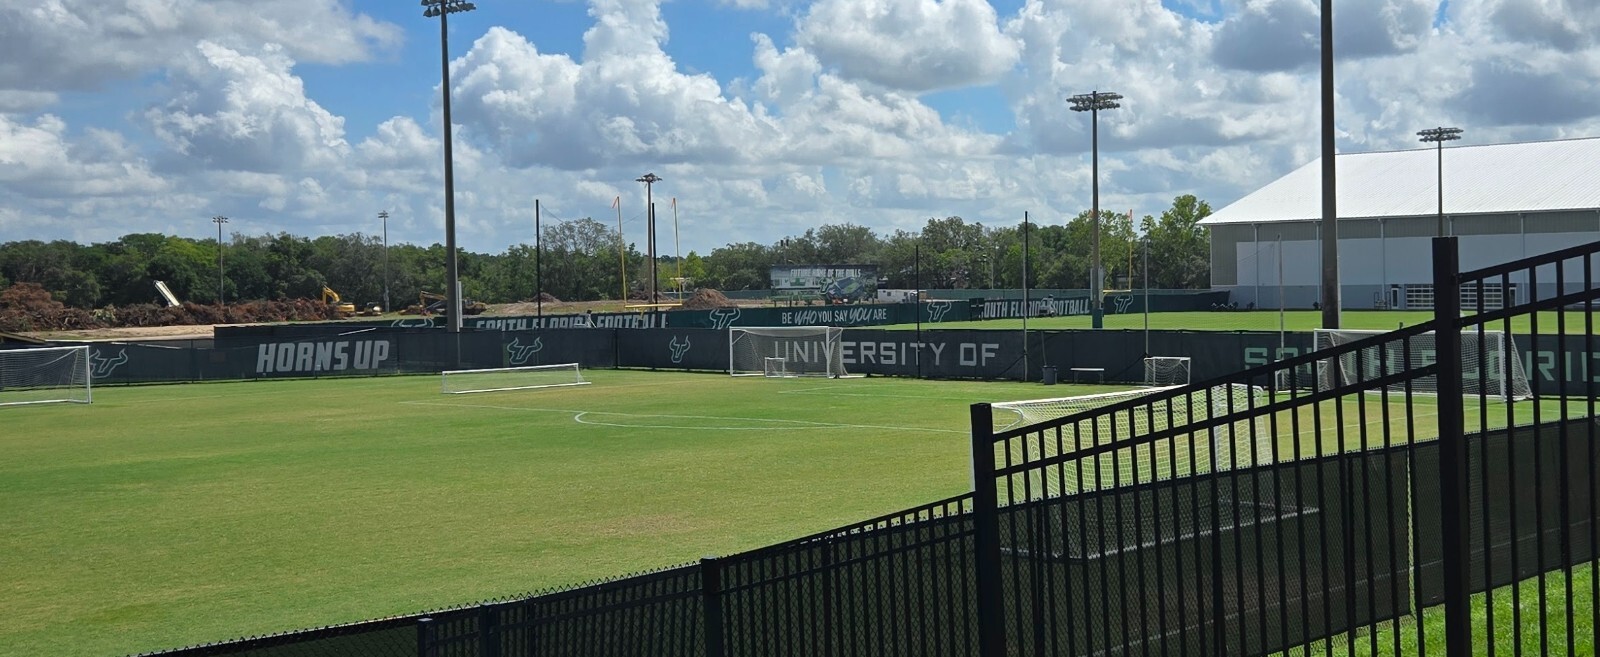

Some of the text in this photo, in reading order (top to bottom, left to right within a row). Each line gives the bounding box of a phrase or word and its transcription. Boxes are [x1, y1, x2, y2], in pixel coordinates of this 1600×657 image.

[827, 268, 834, 278] OF
[835, 268, 845, 278] THE
[782, 307, 887, 325] BE WHO YOU SAY YOU ARE
[984, 301, 1008, 318] OUTH
[256, 340, 390, 373] HORNS UP
[774, 340, 1000, 367] UNIVERSITY OF
